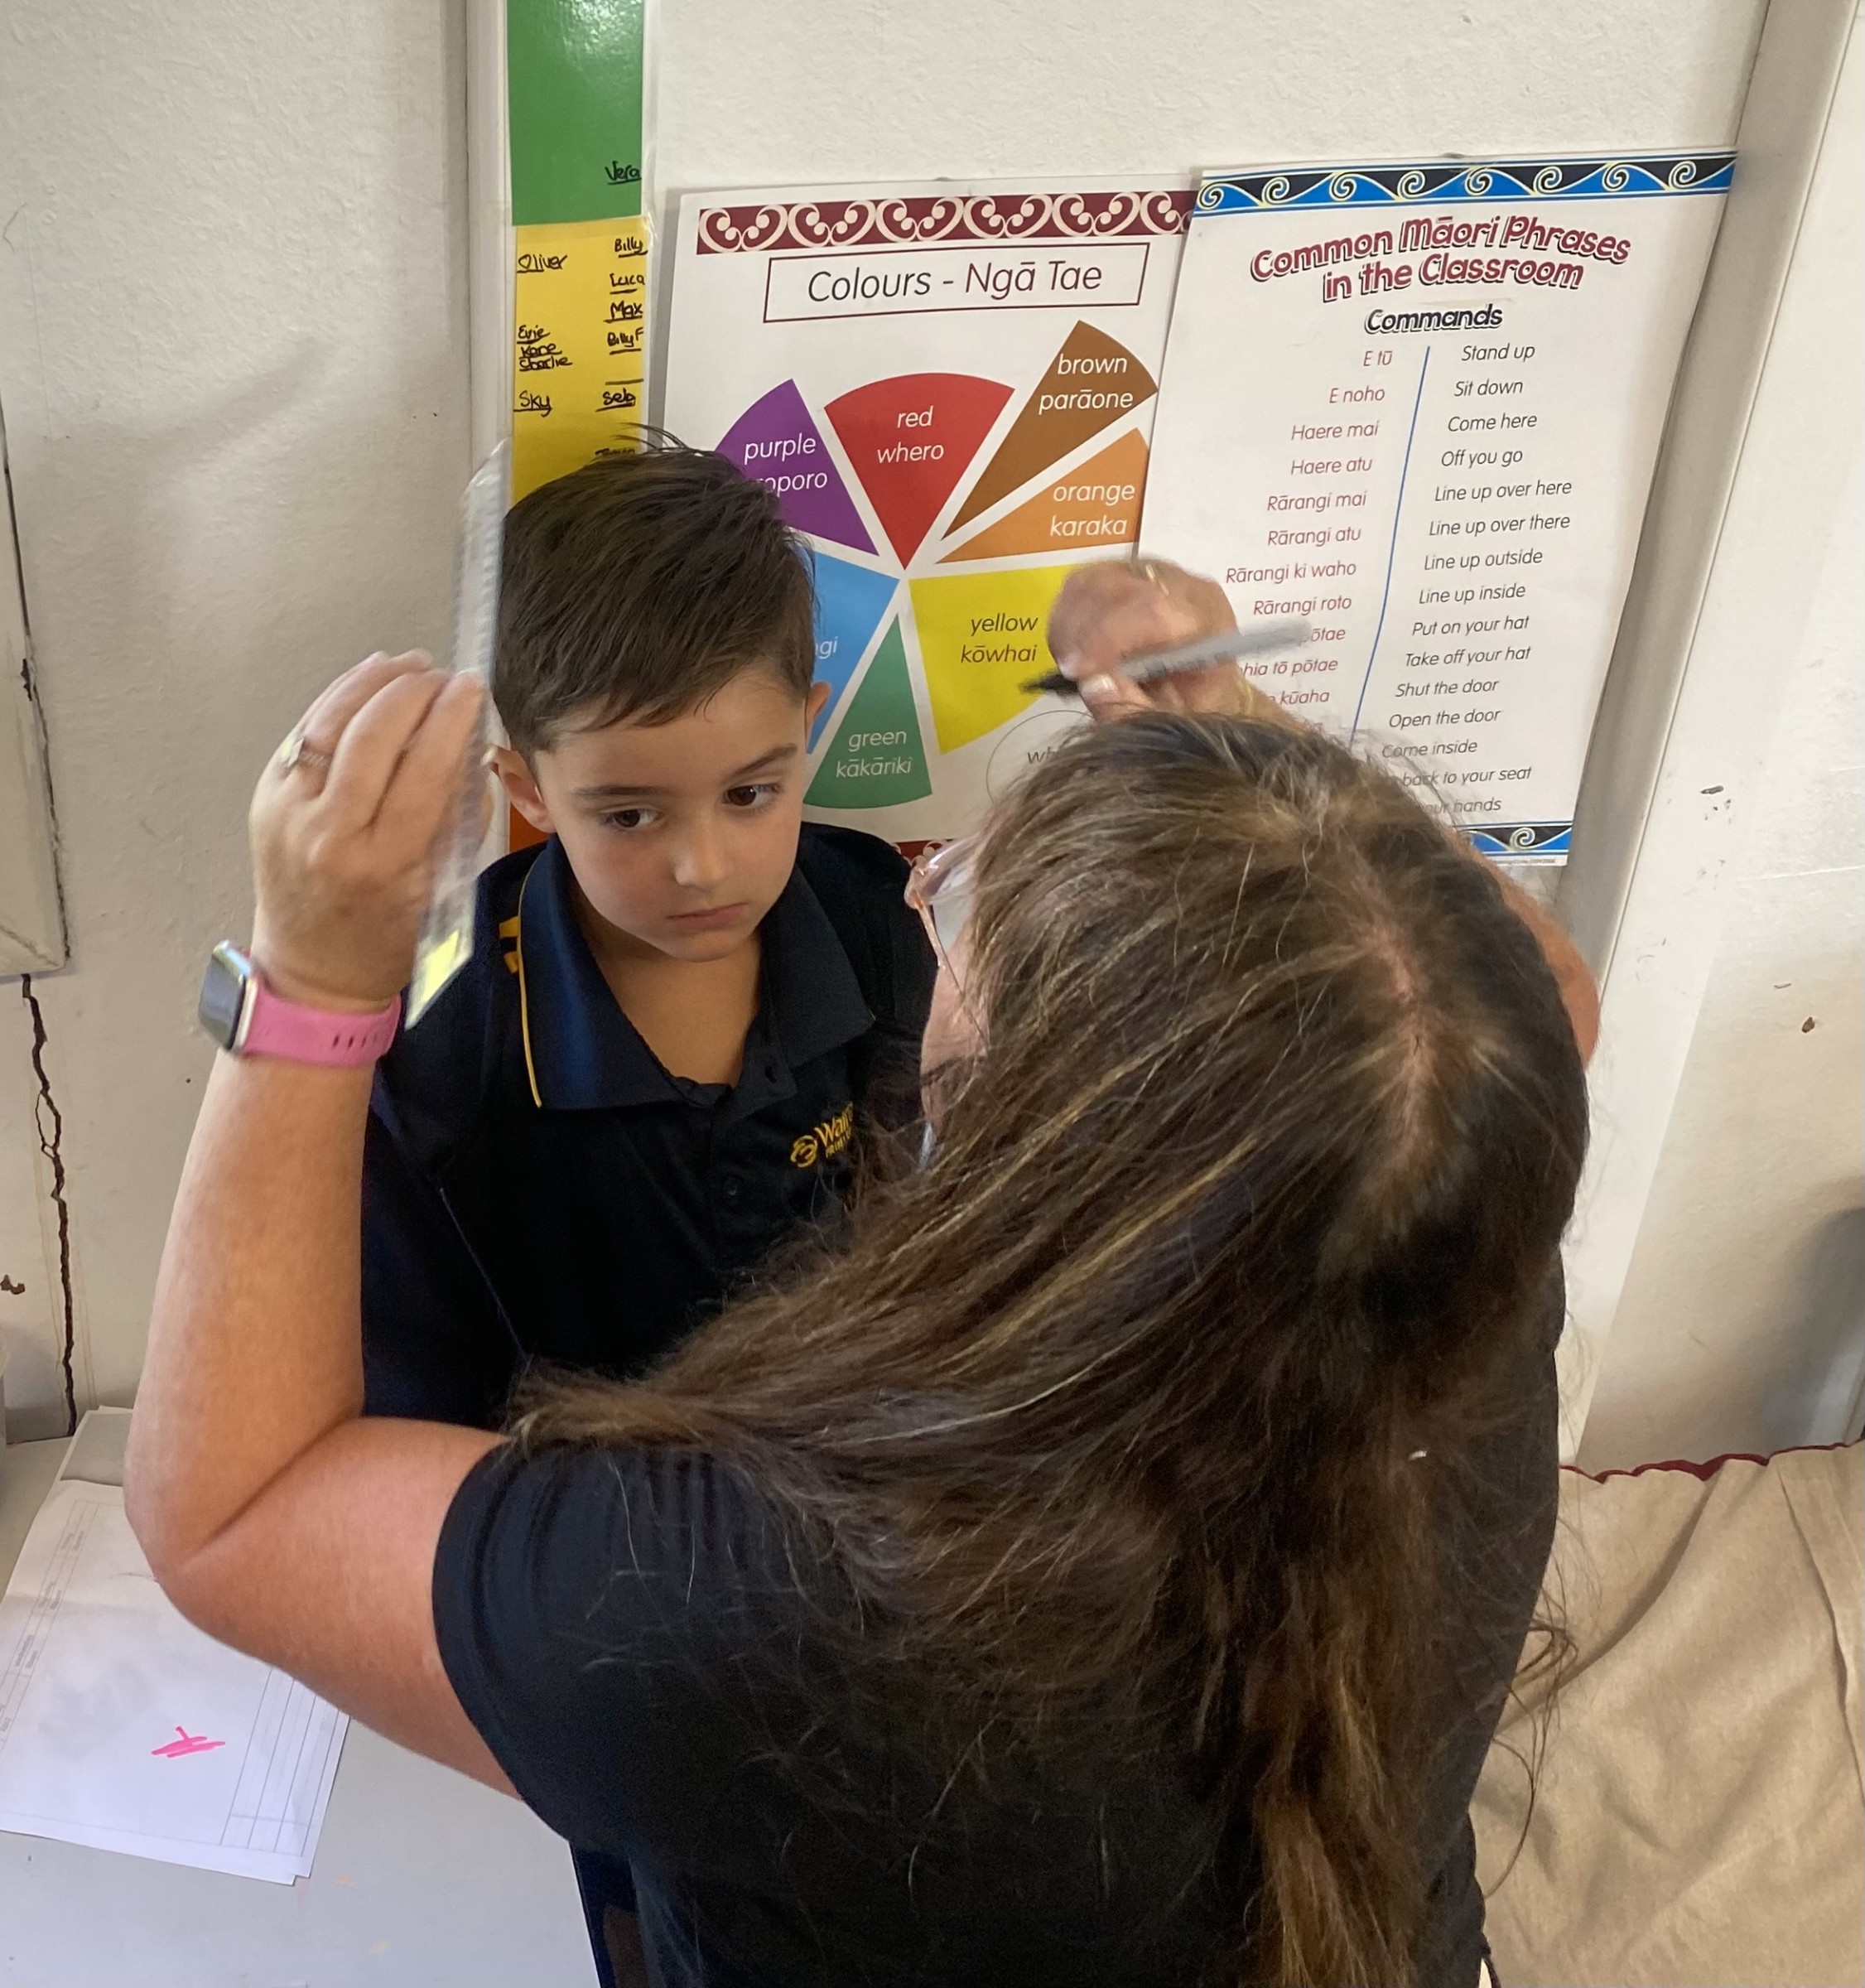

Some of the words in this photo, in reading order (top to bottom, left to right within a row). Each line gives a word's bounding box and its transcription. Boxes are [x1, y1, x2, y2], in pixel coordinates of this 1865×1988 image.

[605, 161, 642, 181] Vera
[614, 236, 645, 255] Billy
[1251, 230, 1393, 282] Common
[1399, 216, 1500, 253] Māori
[1503, 215, 1631, 265] Phrases
[518, 254, 567, 271] Oliver
[809, 268, 931, 302] Colours
[966, 262, 1035, 300] Ngā
[1049, 261, 1101, 291] Tae
[1323, 271, 1352, 303] in
[1359, 262, 1412, 296] the
[1418, 253, 1583, 290] Classroom
[609, 300, 643, 320] Max
[1365, 304, 1502, 334] Commands
[1364, 351, 1373, 366] E
[1378, 351, 1392, 365] tū
[1462, 344, 1510, 360] Stand
[1514, 346, 1535, 362] up
[1058, 354, 1127, 374] brown
[1329, 388, 1338, 403] E
[1343, 386, 1385, 402] noho
[1454, 382, 1472, 396] Sit
[1477, 379, 1523, 395] down
[518, 390, 552, 417] Sky
[1039, 389, 1134, 415] parāone
[898, 406, 933, 427] red
[1448, 417, 1496, 432] Come
[1501, 413, 1537, 428] here
[1292, 425, 1342, 441] Haere
[1347, 422, 1378, 437] mai
[745, 433, 816, 465] purple
[878, 442, 943, 463] whero
[1442, 450, 1466, 466] Off
[1469, 451, 1497, 468] you
[1501, 451, 1522, 467] go
[1291, 460, 1341, 475] Haere
[1347, 457, 1372, 471] atu
[757, 472, 828, 498] oporo
[1053, 485, 1135, 505] orange
[1435, 487, 1466, 501] Line
[1472, 485, 1492, 502] up
[1497, 485, 1531, 497] over
[1536, 480, 1571, 495] here
[1268, 495, 1330, 512] Rārangi
[1336, 492, 1366, 506] mai
[1051, 515, 1127, 536] karaka
[1429, 520, 1460, 535] Line
[1466, 520, 1486, 537] up
[1491, 519, 1525, 532] over
[1530, 514, 1569, 530] there
[1269, 529, 1330, 547] Rārangi
[1336, 527, 1361, 541] atu
[1424, 556, 1455, 570] Line
[1460, 555, 1480, 571] up
[1486, 548, 1542, 567] outside
[1226, 566, 1289, 584] Rārangi
[1294, 563, 1306, 578] ki
[1312, 561, 1356, 577] waho
[1419, 590, 1449, 604] Line
[1455, 589, 1474, 604] up
[1480, 583, 1525, 600] inside
[1254, 598, 1316, 615] Rārangi
[1321, 596, 1352, 610] roto
[971, 613, 1038, 636] yellow
[1413, 622, 1437, 635] Put
[1442, 623, 1461, 634] on
[1466, 620, 1500, 635] your
[1504, 616, 1529, 630] hat
[961, 644, 1037, 663] kōwhai
[1406, 652, 1439, 666] Take
[1443, 649, 1466, 664] off
[1467, 651, 1502, 666] your
[1506, 647, 1530, 660] hat
[1242, 663, 1268, 676] hia
[1273, 662, 1288, 673] tō
[1291, 659, 1337, 676] pōtae
[1280, 689, 1329, 705] kūaha
[1395, 683, 1430, 697] Shut
[1434, 681, 1458, 694] the
[1463, 679, 1499, 692] door
[1390, 714, 1431, 730] Open
[1437, 711, 1460, 725] the
[1464, 709, 1501, 722] door
[849, 730, 906, 751] green
[1433, 740, 1477, 755] inside
[836, 756, 912, 778] kākāriki
[1443, 772, 1457, 784] to
[1462, 771, 1495, 785] your
[1499, 767, 1531, 780] seat
[1421, 802, 1449, 813] our
[1453, 798, 1501, 813] hands
